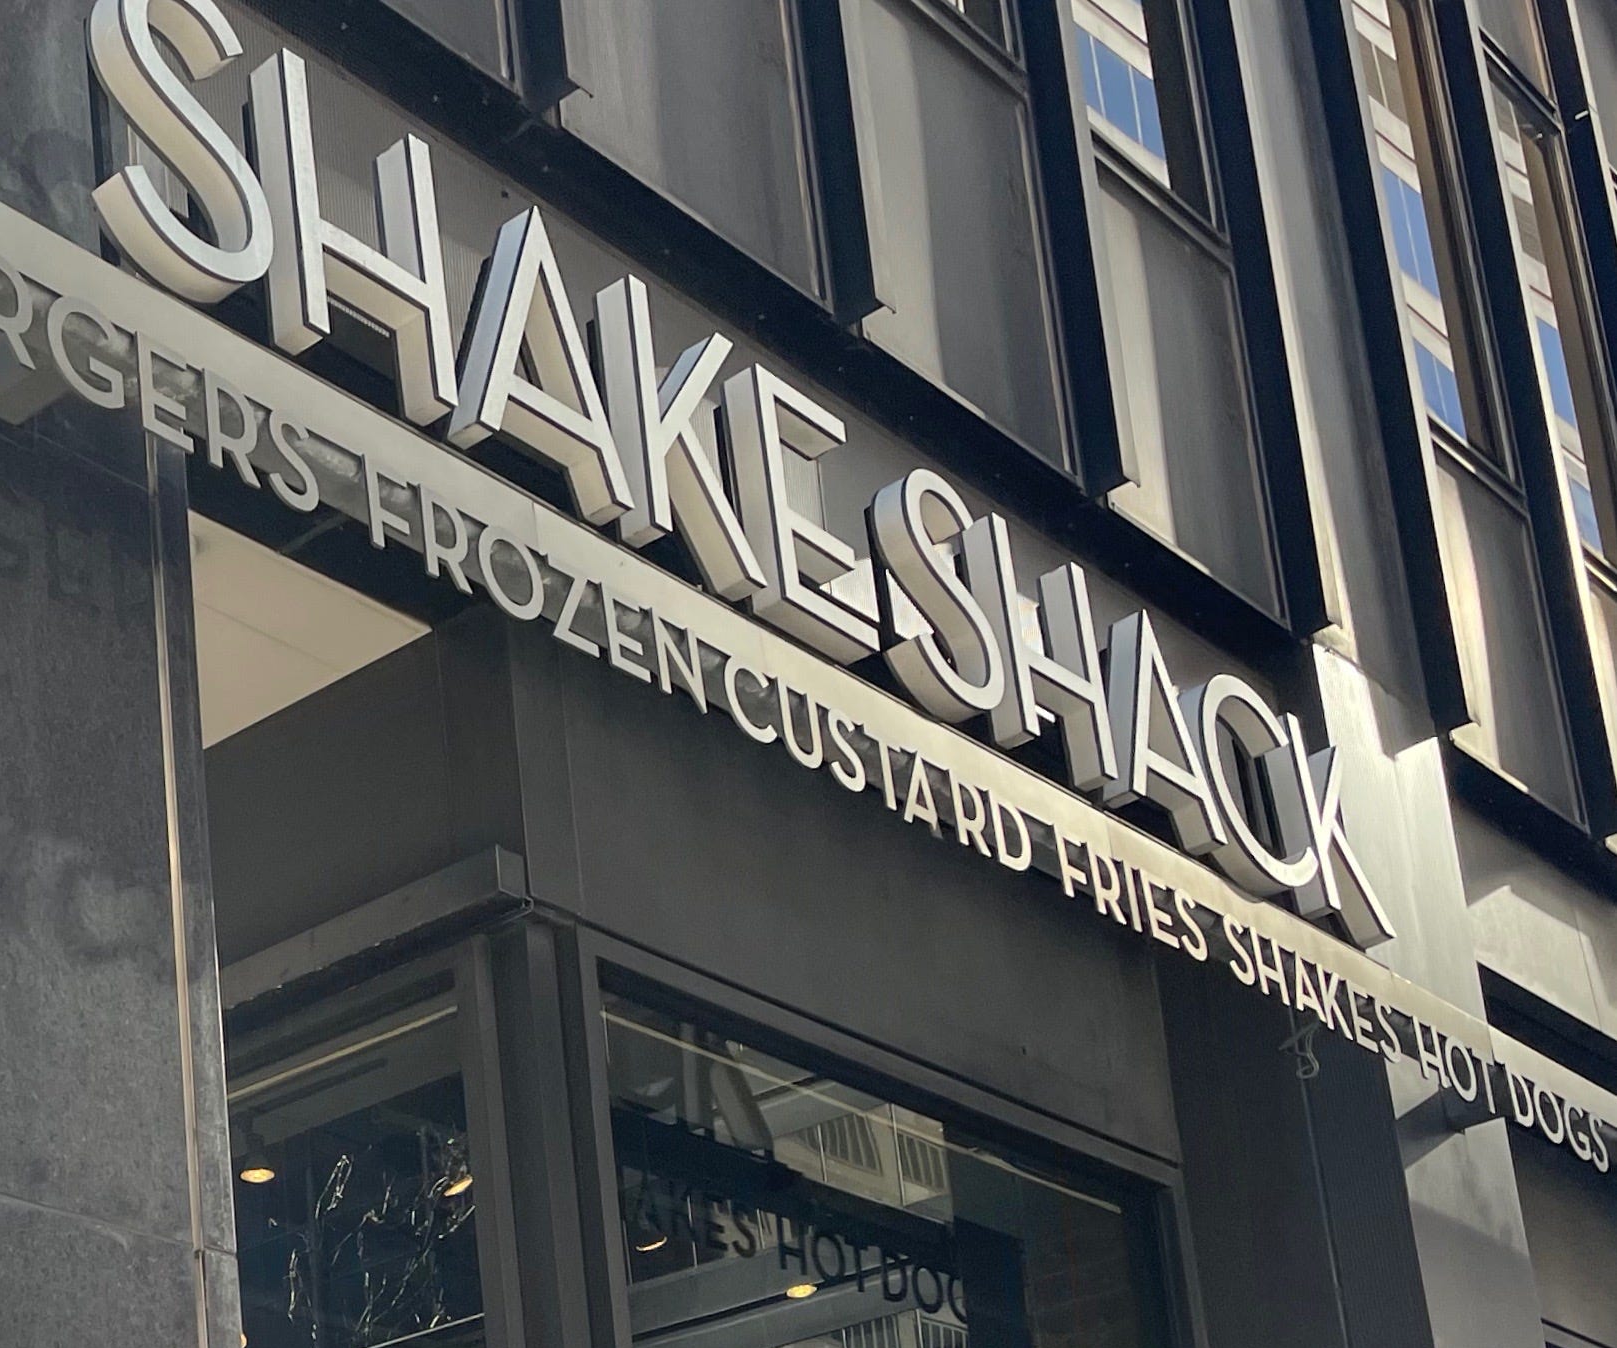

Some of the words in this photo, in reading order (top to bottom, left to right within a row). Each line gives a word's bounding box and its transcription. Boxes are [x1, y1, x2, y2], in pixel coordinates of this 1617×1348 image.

[86, 0, 880, 668] SHAKE
[868, 467, 1395, 949] SHACK
[361, 452, 709, 715] FROZEN
[723, 655, 1033, 874] CUSTARD
[1052, 823, 1209, 962] FRIES
[1220, 912, 1402, 1065] SHAKES
[1413, 1023, 1506, 1116] HOT
[1506, 1065, 1610, 1175] DOGS
